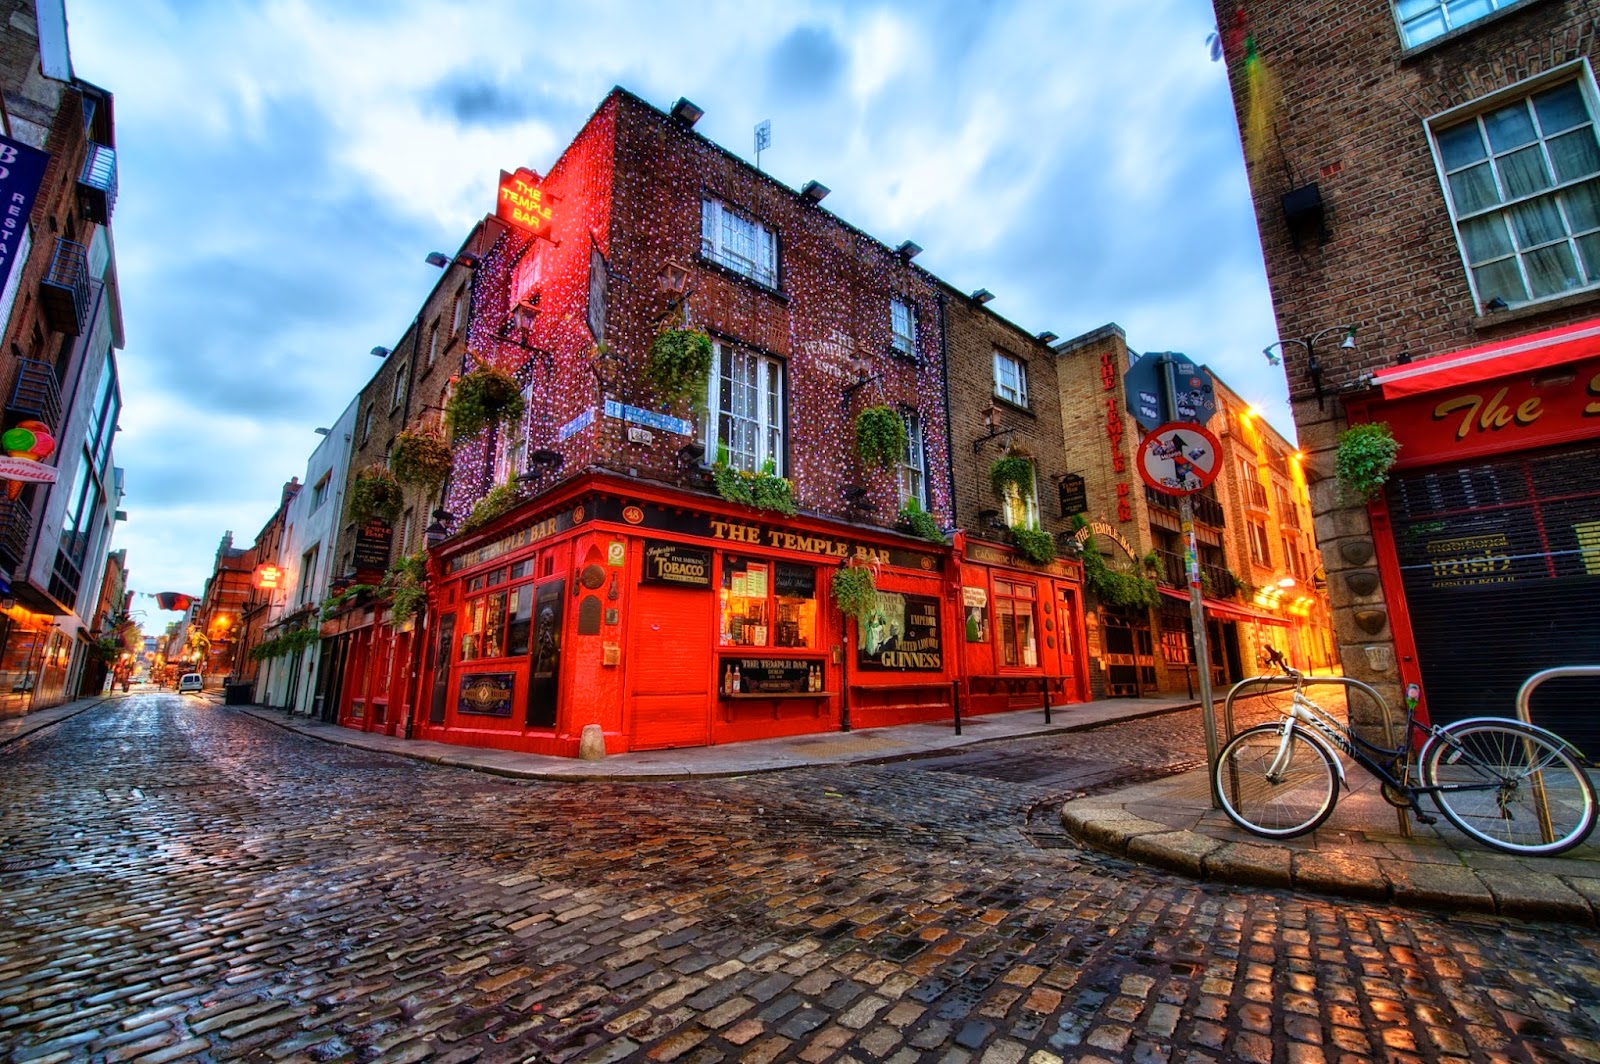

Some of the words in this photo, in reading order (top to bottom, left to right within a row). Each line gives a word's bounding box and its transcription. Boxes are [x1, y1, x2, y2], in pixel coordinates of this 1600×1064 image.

[501, 187, 552, 219] TEMPLE
[516, 180, 541, 201] THE
[513, 208, 539, 229] BAR
[1101, 353, 1115, 390] THE
[1434, 387, 1544, 440] The
[1106, 398, 1125, 473] TEMPLE
[0, 467, 54, 480] otticelli
[626, 509, 639, 519] 48
[1117, 482, 1132, 522] BAR
[462, 553, 480, 569] THE
[484, 531, 525, 559] TEMPLE
[530, 517, 557, 542] BAR
[710, 521, 760, 544] THE
[768, 531, 848, 557] TEMPLE
[855, 545, 891, 564] BAR
[1075, 526, 1090, 543] THE
[1090, 522, 1119, 540] TEMPLE
[1120, 535, 1135, 560] BAR
[924, 605, 935, 615] THE
[742, 660, 759, 669] THE
[760, 660, 791, 669] TEMPLE
[793, 660, 808, 669] BAR
[881, 651, 940, 668] GUINNESS
